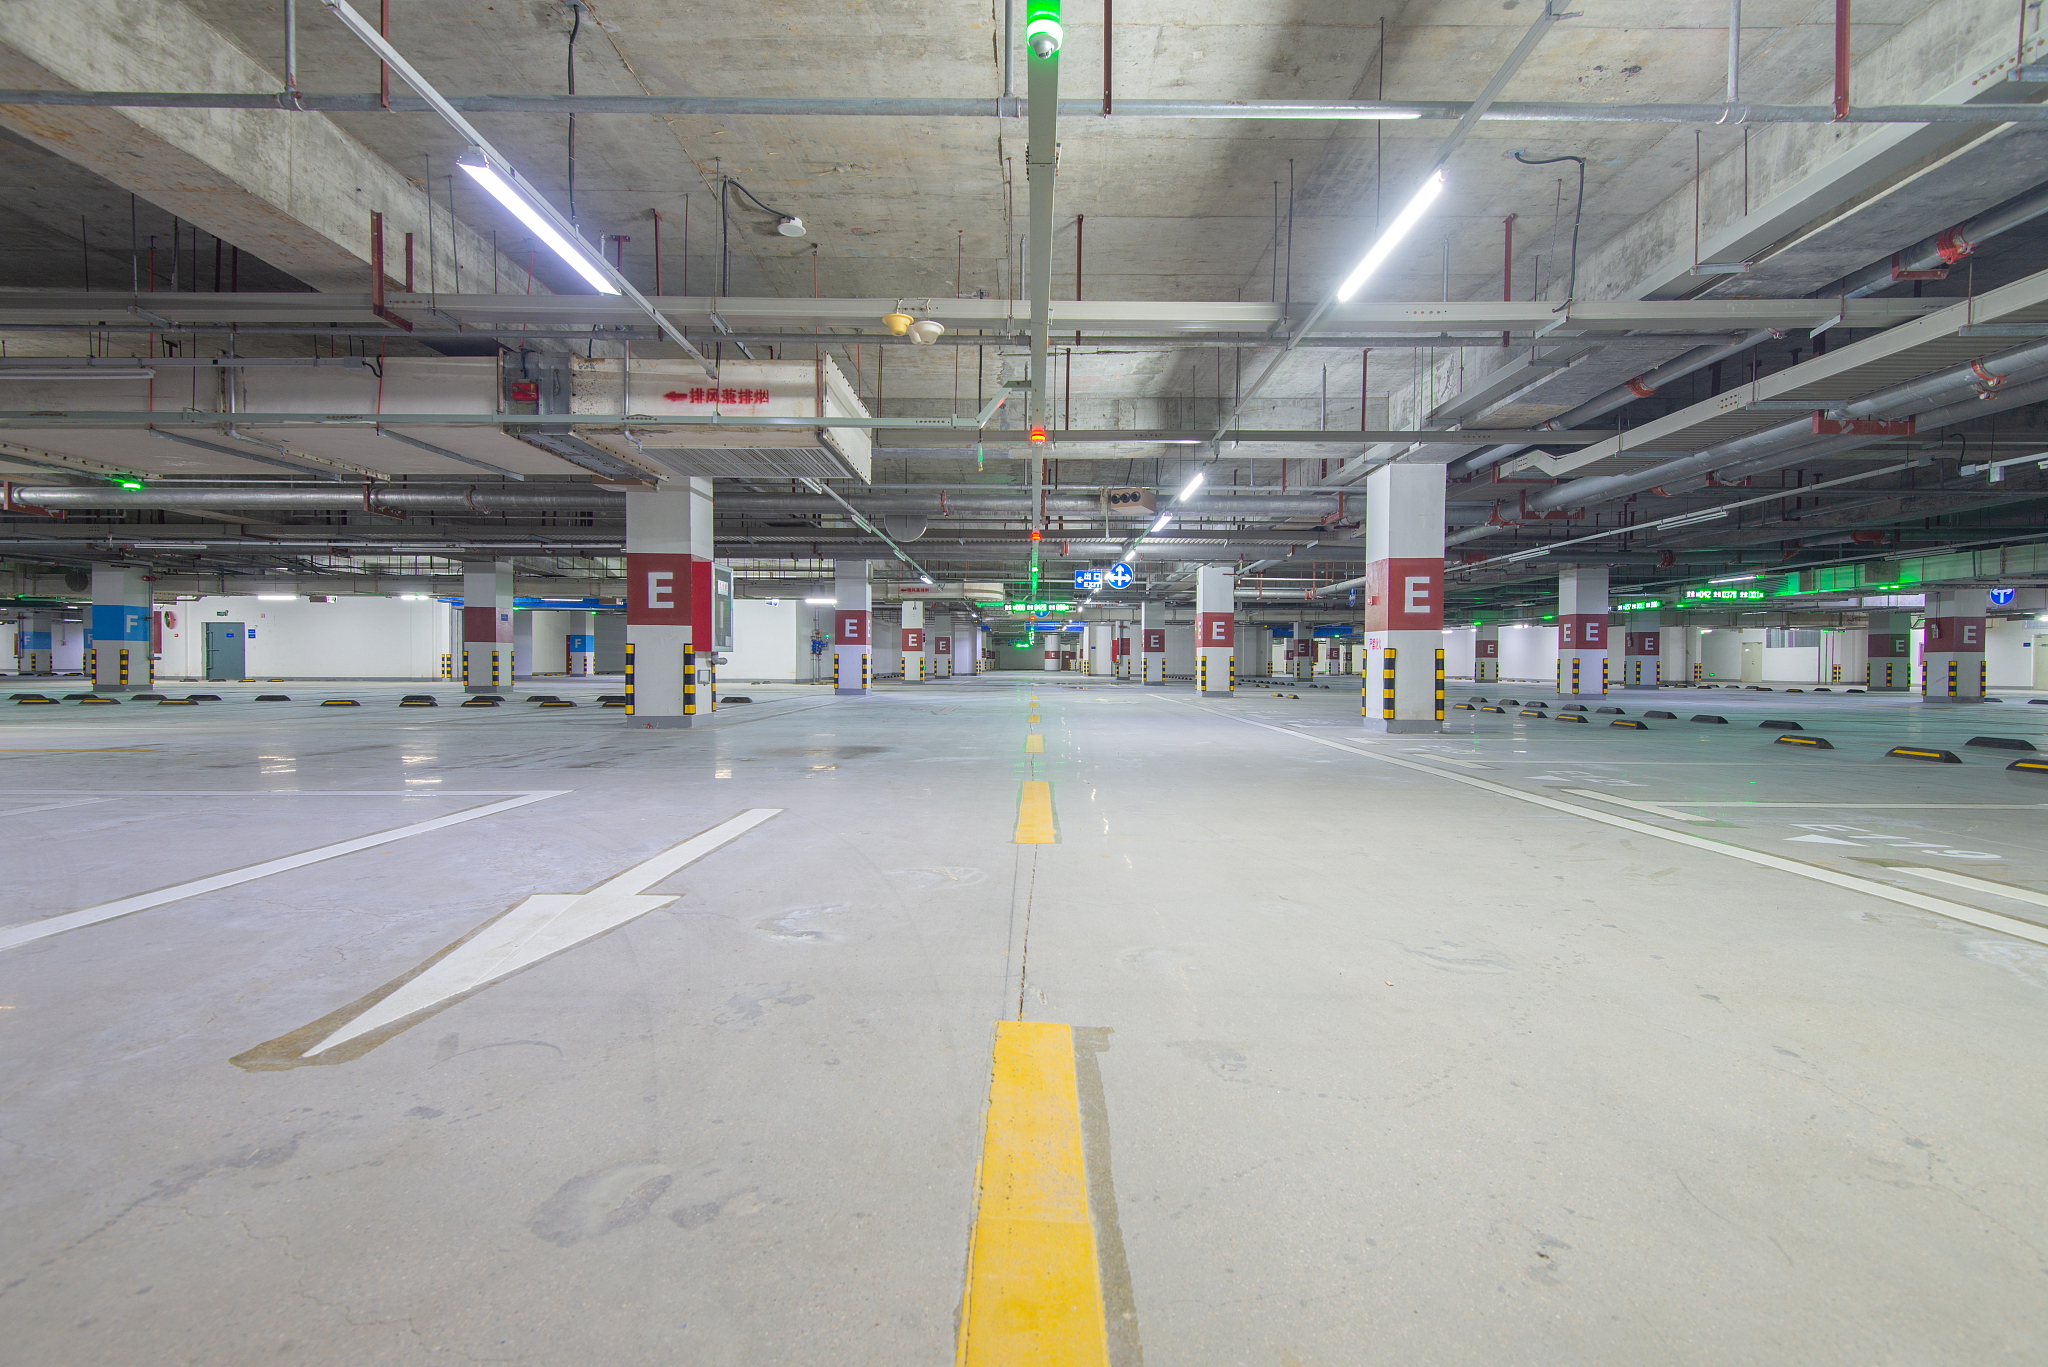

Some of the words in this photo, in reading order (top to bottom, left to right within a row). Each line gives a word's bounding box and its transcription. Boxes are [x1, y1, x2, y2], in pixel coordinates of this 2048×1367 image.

[689, 388, 769, 404] 排风兼排烟
[1084, 572, 1101, 581] 出口
[648, 572, 674, 609] E
[1083, 581, 1101, 589] EXIT
[1405, 576, 1430, 613] E
[126, 614, 138, 632] F
[845, 619, 857, 637] E
[1198, 621, 1202, 640] E
[1212, 622, 1225, 639] E
[1563, 623, 1571, 642] E
[1586, 623, 1599, 641] E
[1963, 626, 1977, 643] E
[24, 636, 30, 645] F
[575, 639, 581, 648] F
[909, 634, 917, 646] E
[940, 641, 946, 650] E
[1151, 635, 1159, 647] E
[1645, 638, 1653, 650] E
[1896, 640, 1904, 652] E
[1299, 644, 1305, 652] E
[1487, 644, 1494, 653] E
[1789, 823, 2003, 859] E119
